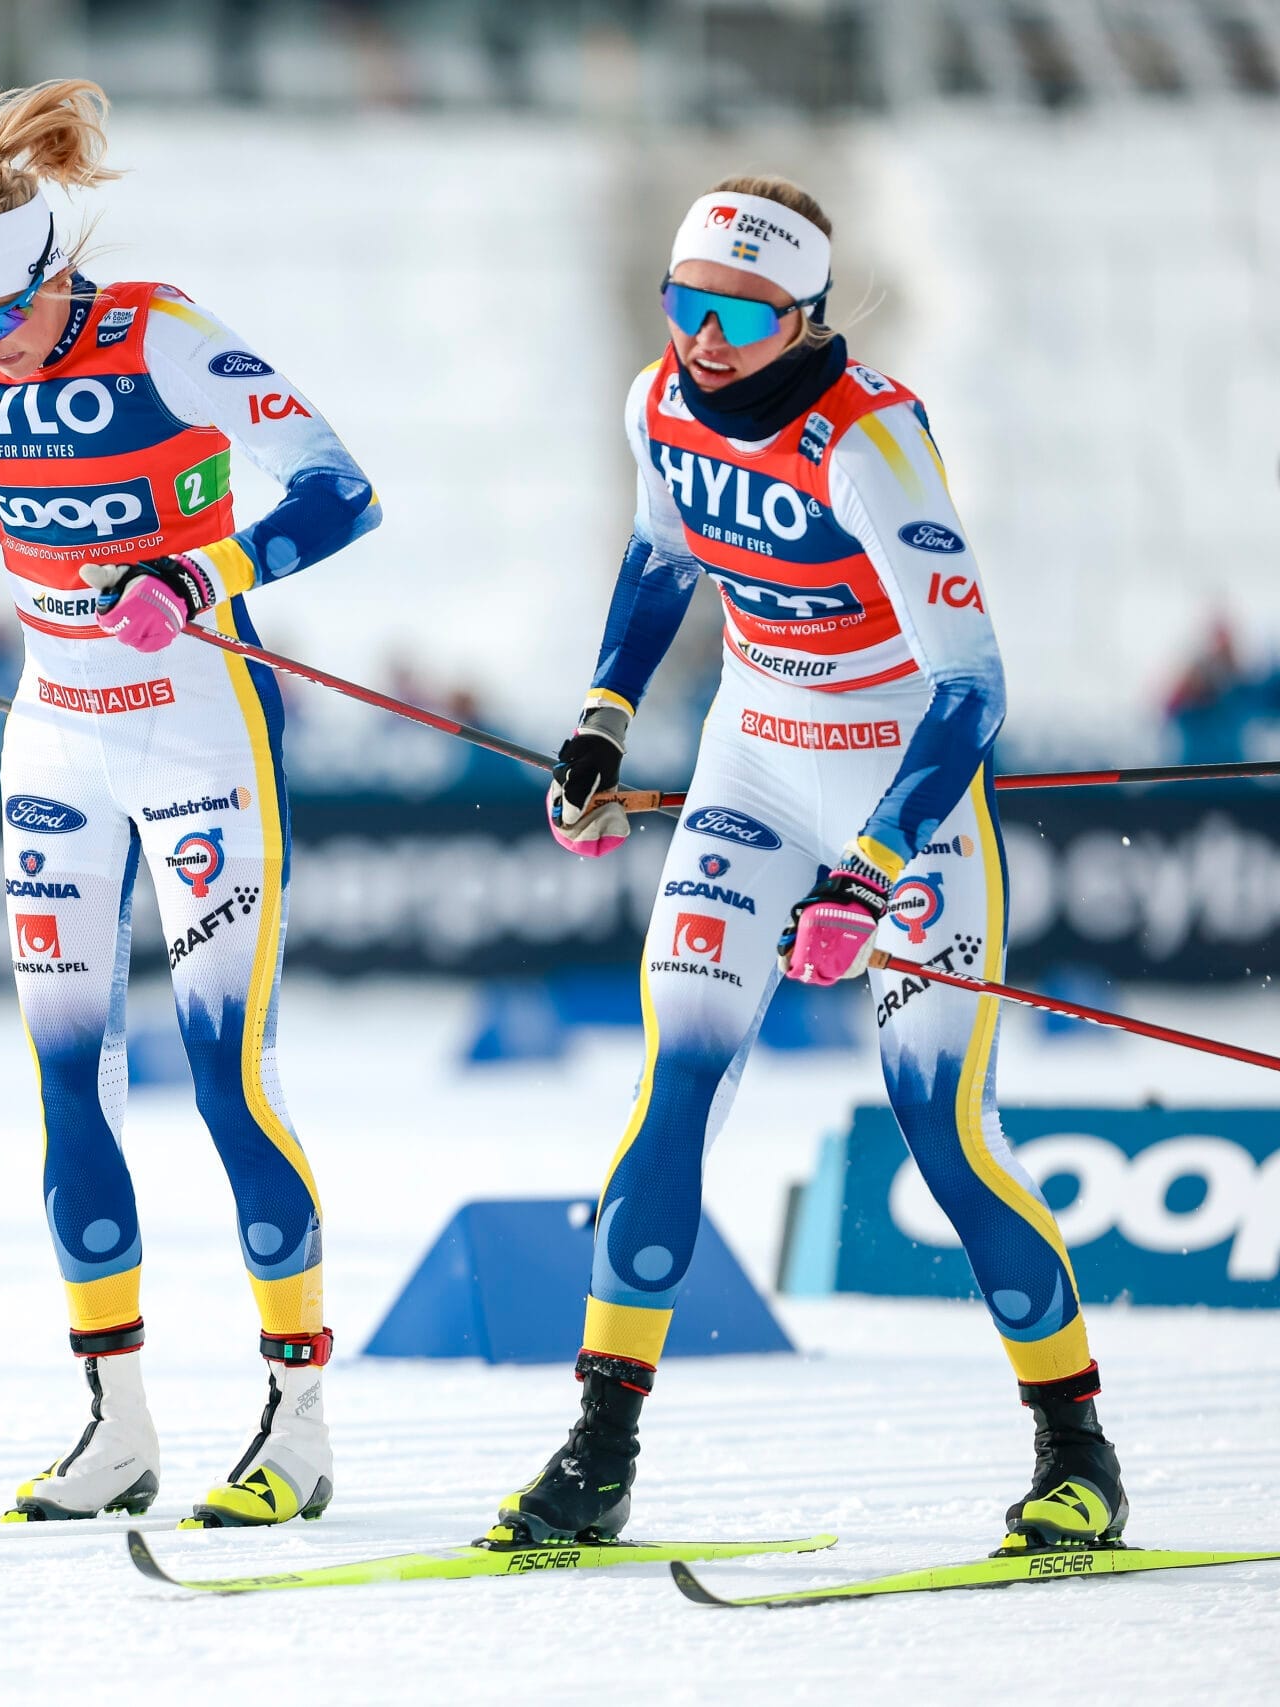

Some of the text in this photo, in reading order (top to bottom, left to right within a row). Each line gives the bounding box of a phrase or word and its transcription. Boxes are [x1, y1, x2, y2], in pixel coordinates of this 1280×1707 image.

[736, 223, 771, 241] SPEL
[741, 213, 800, 249] SVENSKA
[28, 247, 61, 275] CAFT
[223, 354, 264, 374] Ford
[248, 393, 313, 425] ICA
[22, 444, 42, 458] DRY
[47, 444, 75, 457] EYES
[184, 472, 205, 510] 2
[15, 543, 39, 557] CROSS
[39, 549, 86, 561] COUNTRY
[89, 541, 135, 557] WORLD
[138, 536, 164, 550] CUP
[702, 523, 774, 556] FOR DRY EYES
[912, 525, 955, 550] Ford
[46, 595, 99, 617] OBER
[928, 572, 985, 615] ICA
[790, 620, 837, 636] WORLD
[840, 613, 867, 628] CUP
[39, 680, 174, 713] BAUHAUS
[742, 711, 899, 748] BAUHAUS
[11, 800, 67, 829] Ford
[142, 795, 230, 822] Sundström
[696, 809, 763, 843] Ford
[165, 852, 208, 868] Thermia
[6, 879, 81, 899] SCANIA
[664, 880, 756, 915] SCANIA
[885, 896, 926, 913] hermia
[169, 898, 235, 970] CRAFT
[13, 961, 89, 974] VENSKA SPEL
[650, 961, 744, 988] SVENSKA SPEL
[507, 1550, 581, 1572] FISCHER
[1028, 1554, 1094, 1576] FISCHER
